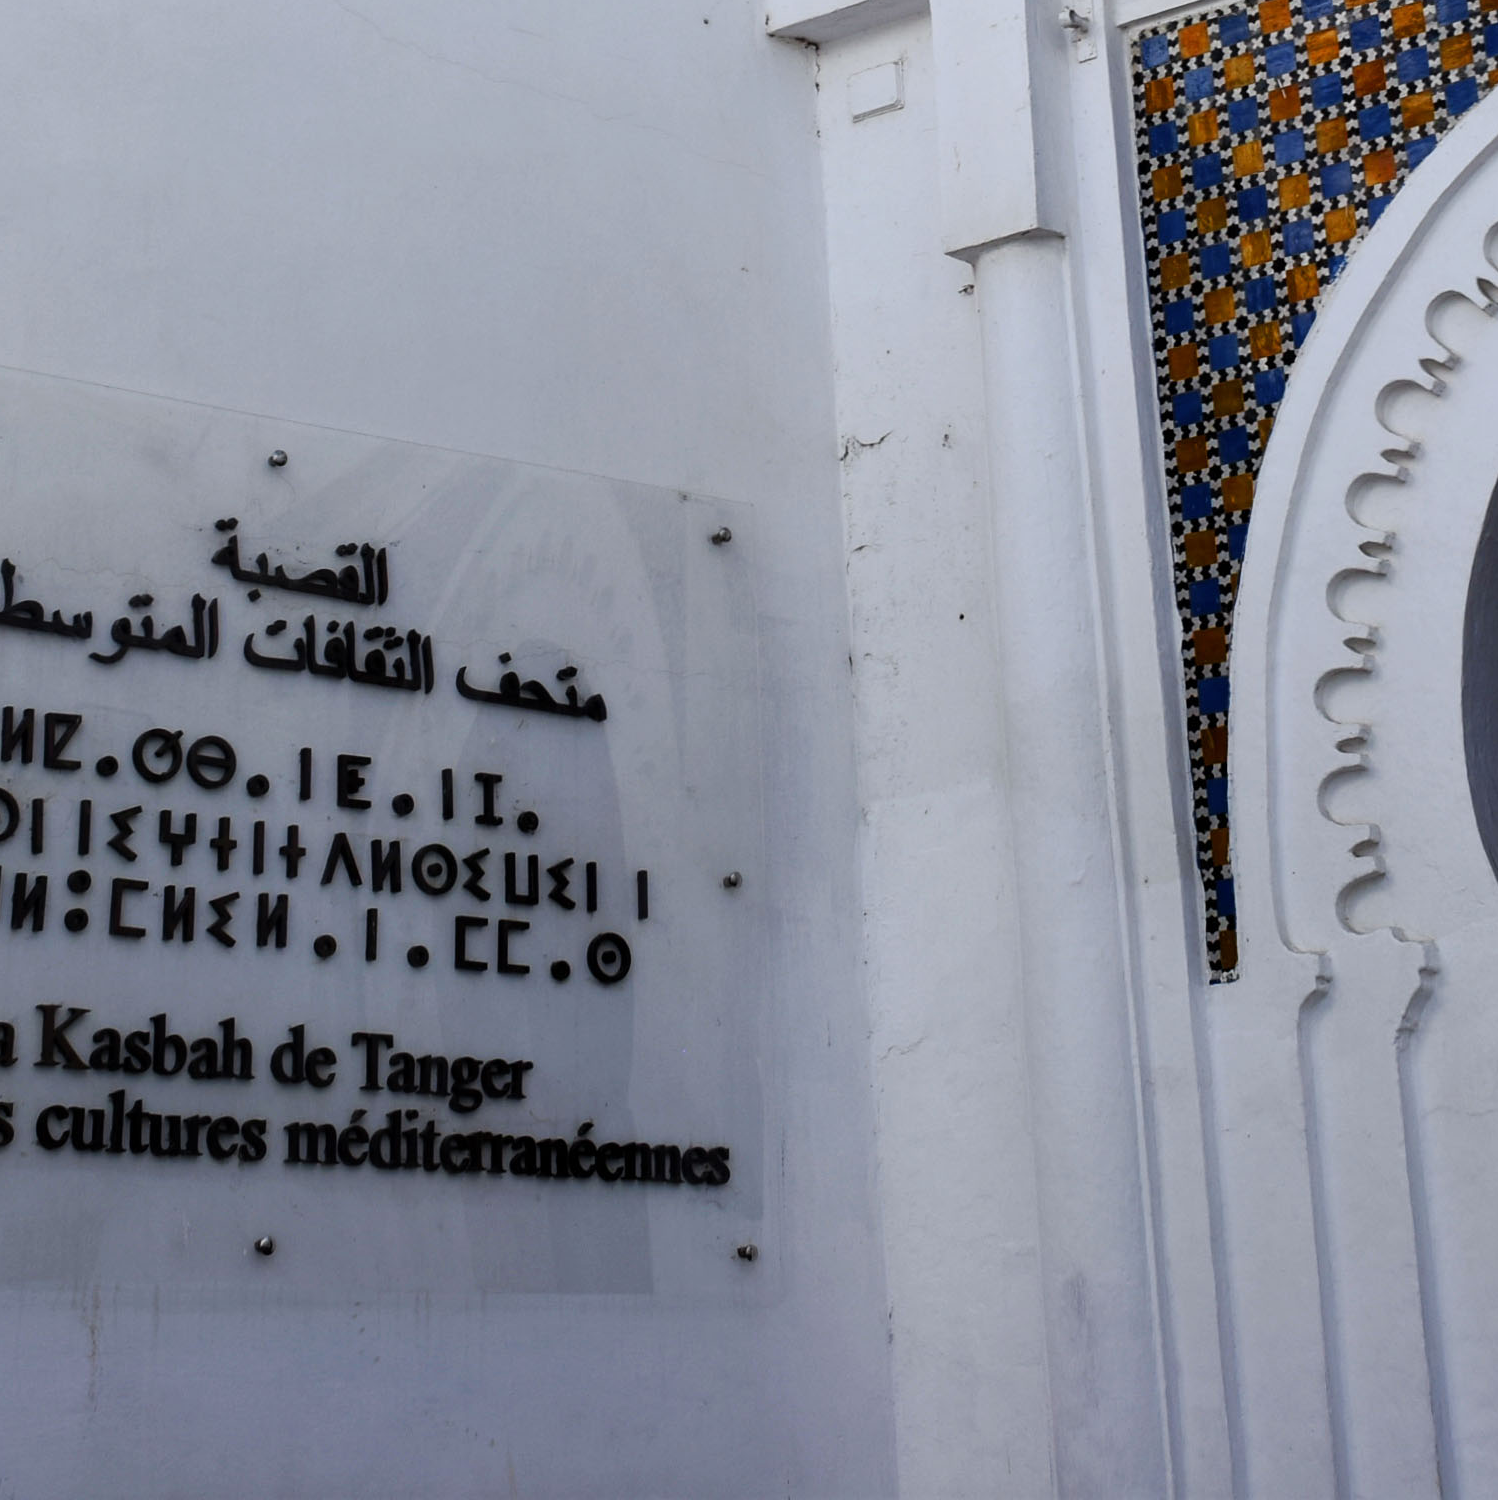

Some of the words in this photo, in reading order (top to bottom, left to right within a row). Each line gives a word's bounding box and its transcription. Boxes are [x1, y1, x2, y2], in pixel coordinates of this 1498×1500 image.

[211, 517, 389, 609] القصبة
[243, 613, 435, 695] الثقافات
[456, 651, 608, 724] متحف
[33, 1004, 256, 1084] Kasbah
[269, 1023, 338, 1092] de
[351, 1031, 534, 1120] Tanger
[35, 1089, 268, 1167] cultures
[282, 1108, 731, 1191] méditerranéennes
